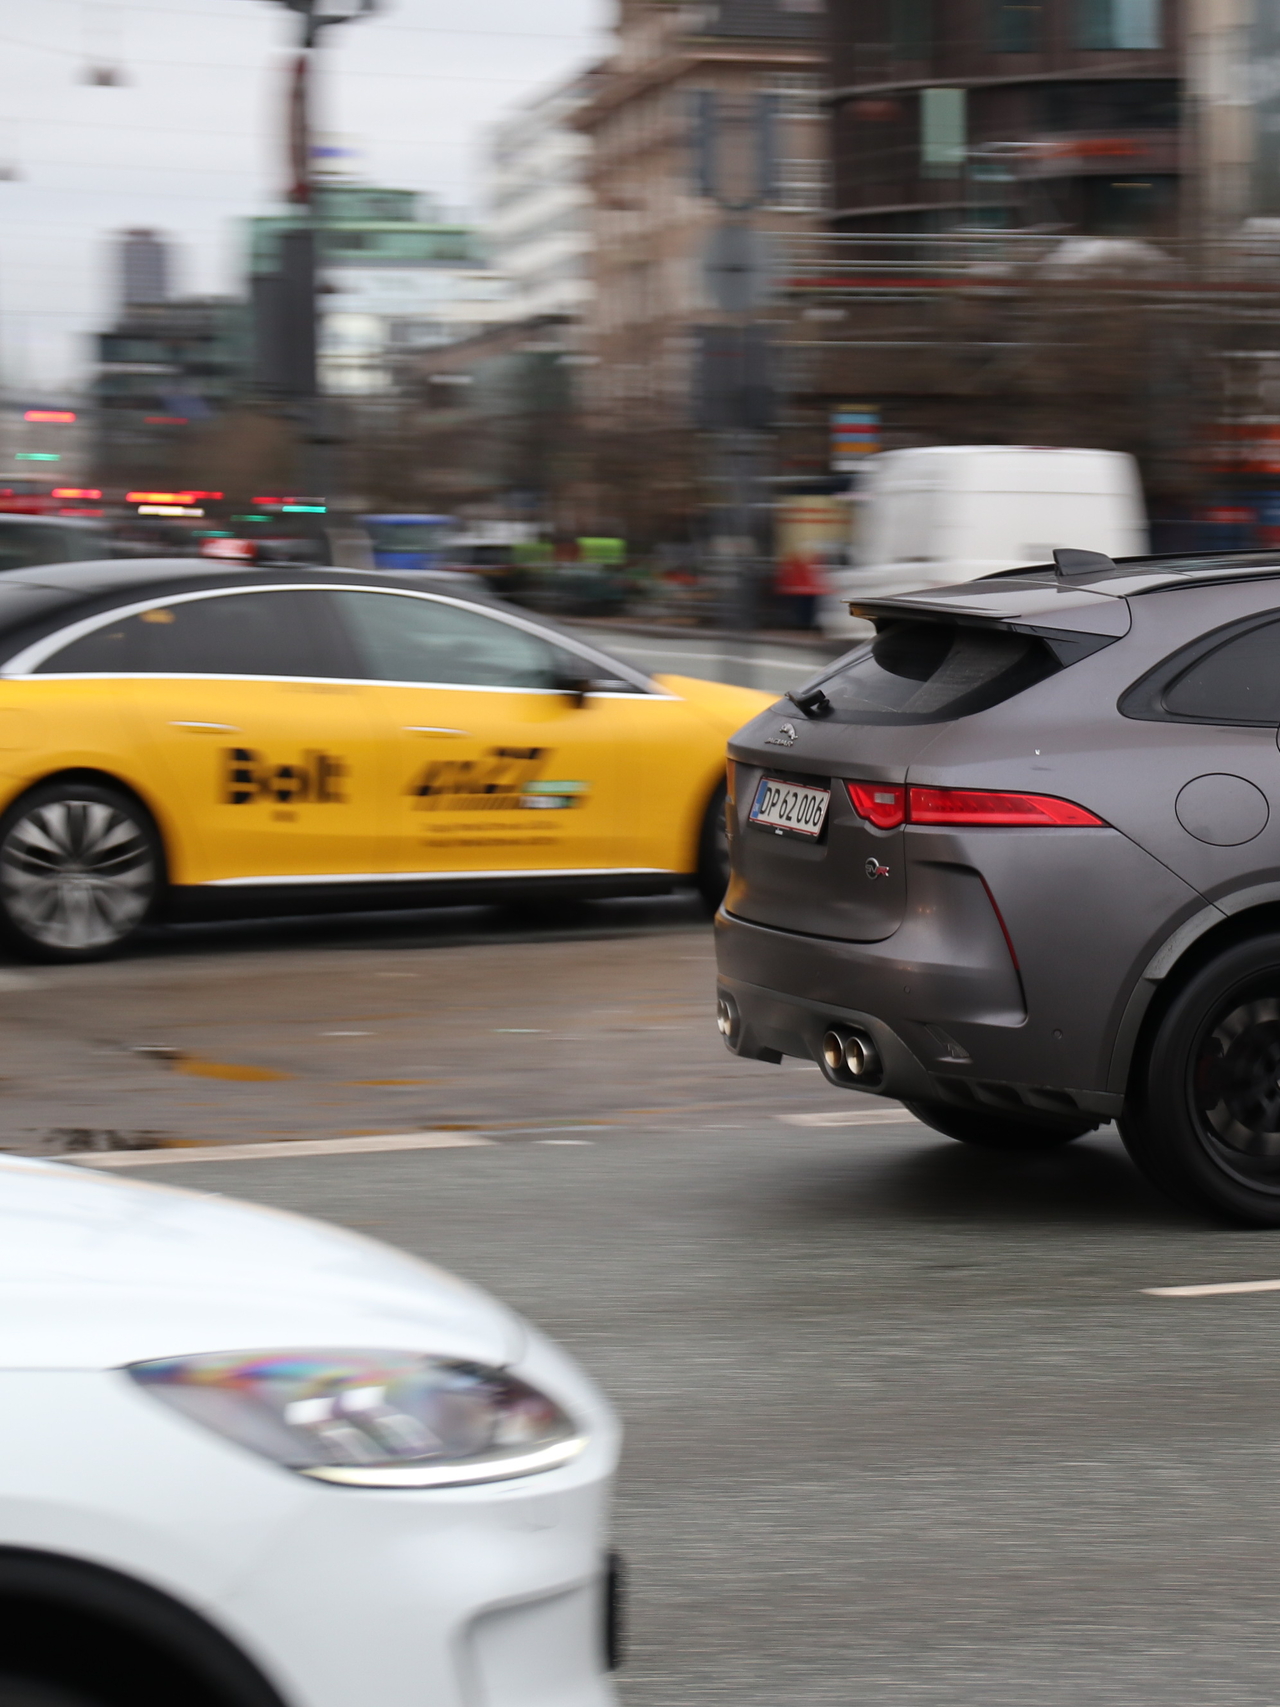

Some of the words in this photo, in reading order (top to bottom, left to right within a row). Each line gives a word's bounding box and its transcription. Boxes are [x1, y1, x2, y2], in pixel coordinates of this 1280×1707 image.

[217, 747, 351, 804] Bolt
[759, 786, 780, 817] DP
[778, 790, 798, 822] 62
[796, 794, 825, 827] 006
